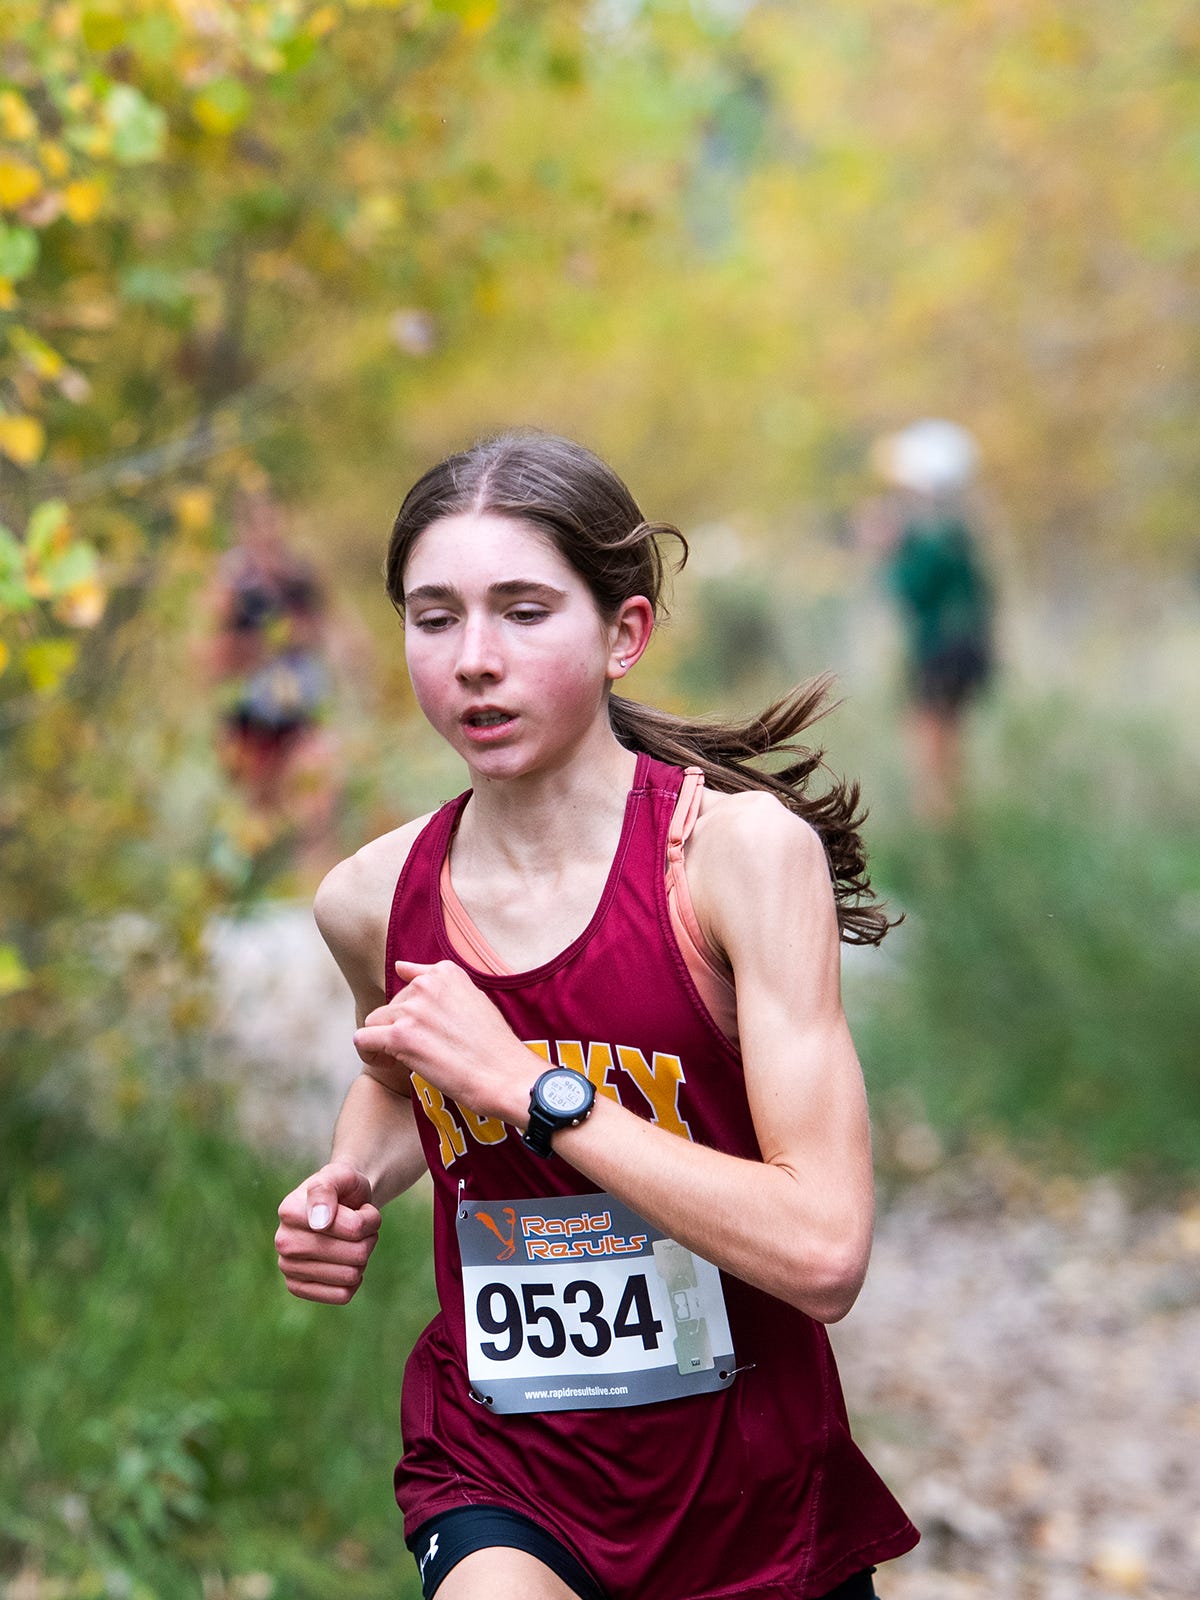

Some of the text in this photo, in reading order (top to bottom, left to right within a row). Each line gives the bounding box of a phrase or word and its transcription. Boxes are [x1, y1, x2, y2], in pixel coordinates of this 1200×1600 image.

[521, 1211, 612, 1237] Rapid
[527, 1234, 647, 1260] Results
[476, 1274, 663, 1361] 9534
[525, 1386, 628, 1399] www.rapidresultslive.com
